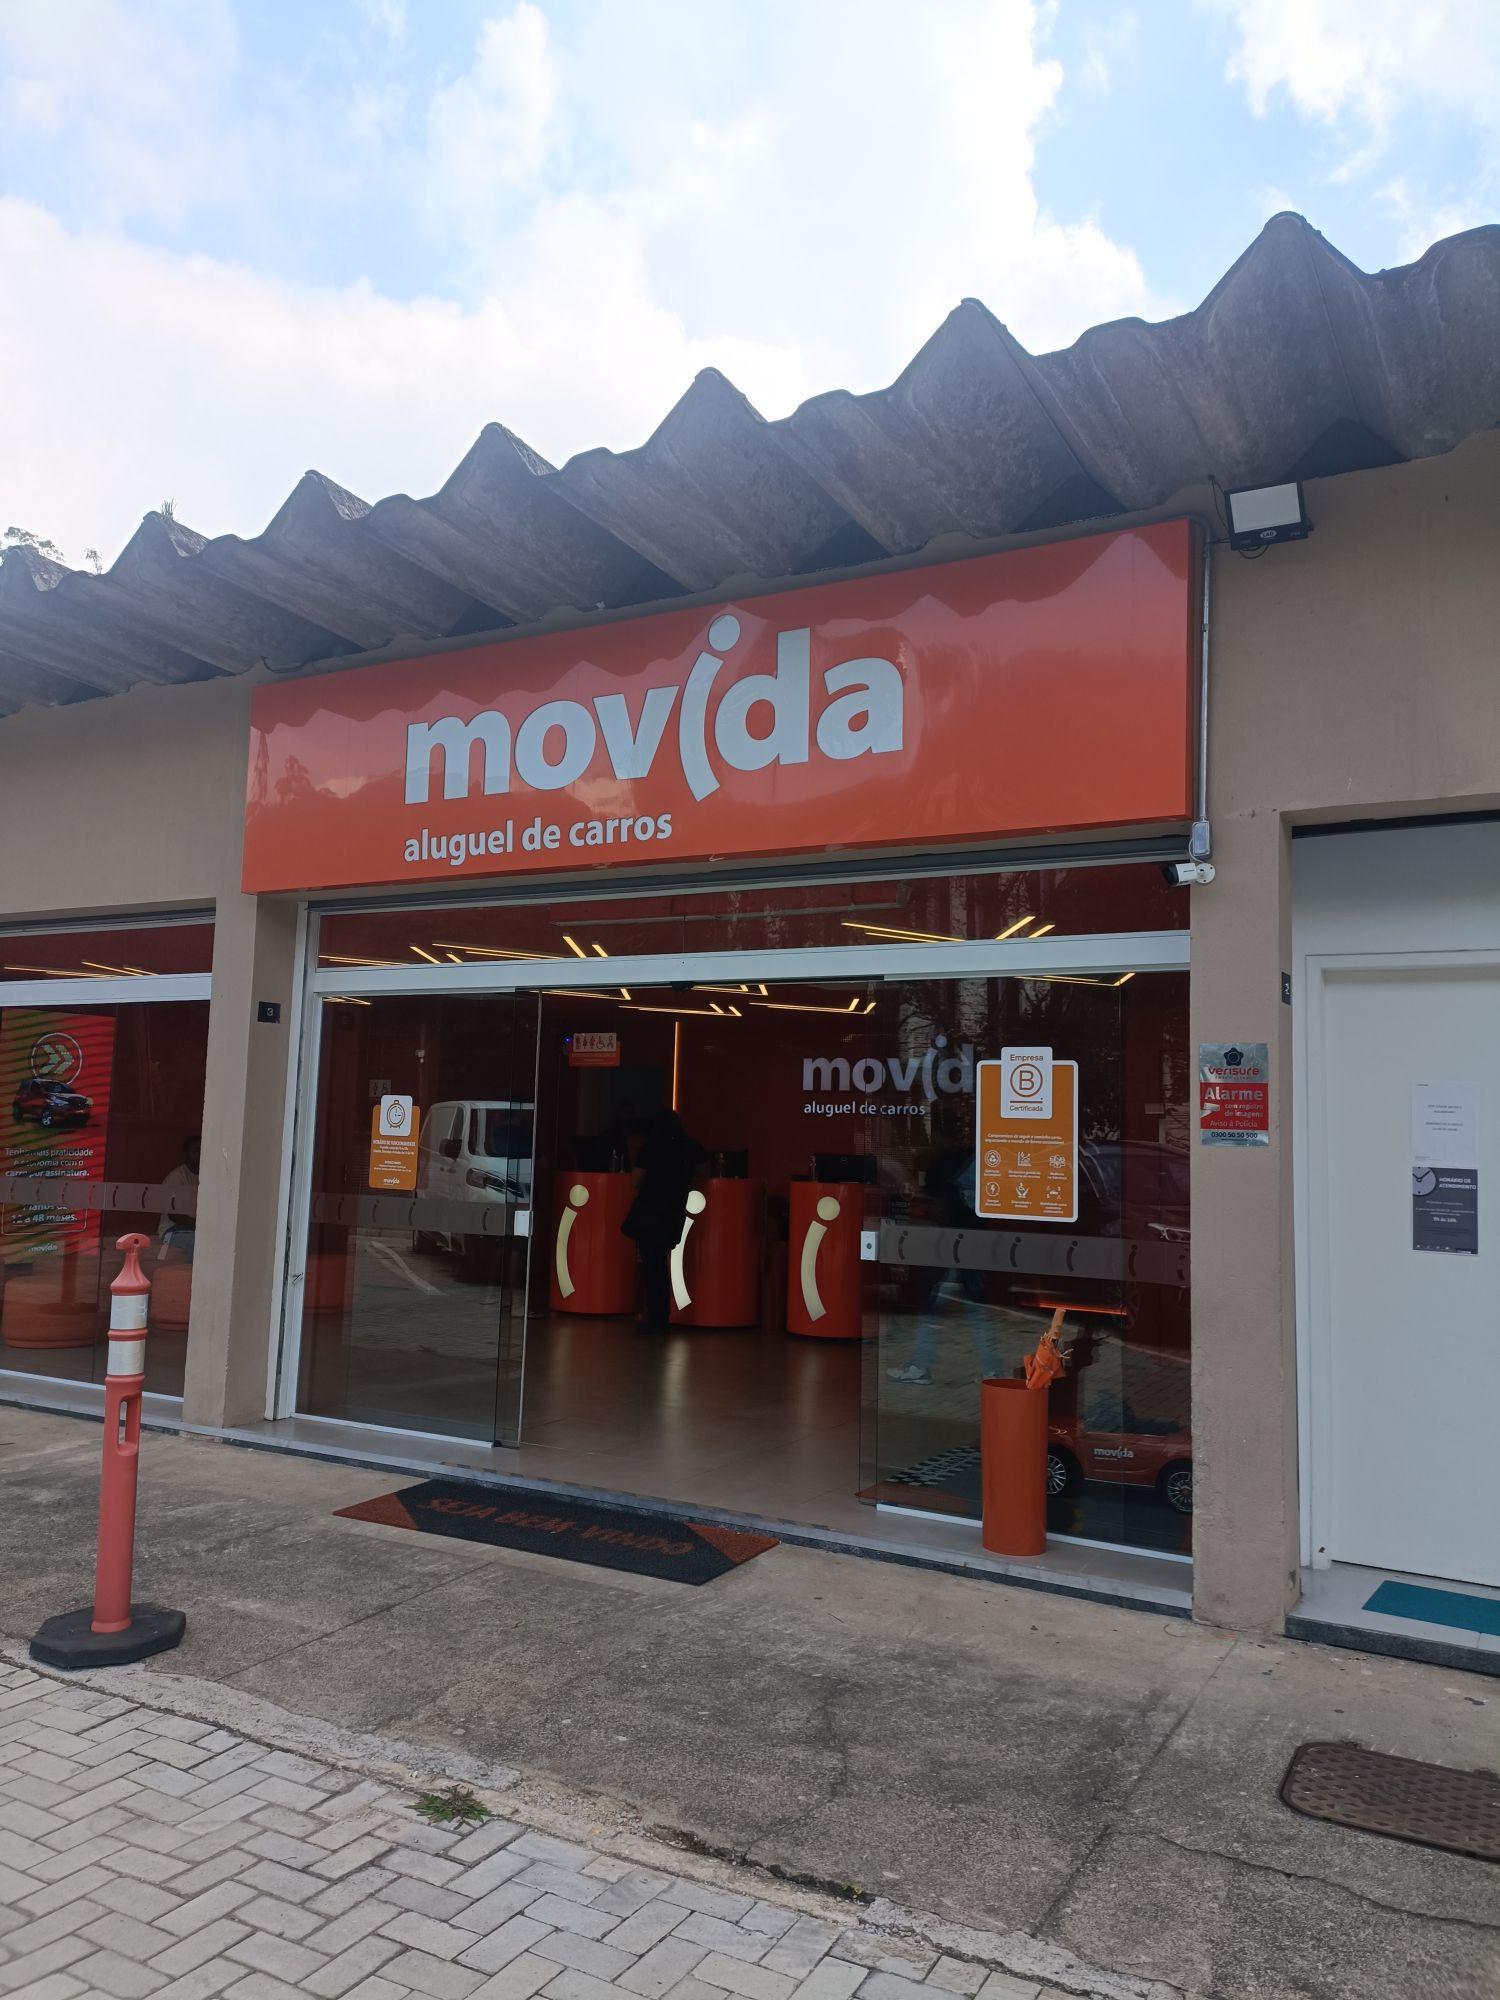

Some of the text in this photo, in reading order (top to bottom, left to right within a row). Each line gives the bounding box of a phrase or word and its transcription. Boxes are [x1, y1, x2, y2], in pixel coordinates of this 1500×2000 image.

[404, 614, 904, 805] movida
[404, 812, 673, 866] aluguel de carros
[267, 1007, 274, 1017] 3
[1009, 1054, 1044, 1062] Empresa
[802, 1034, 975, 1100] movid
[1208, 1066, 1260, 1076] verisure
[1019, 1070, 1035, 1090] B
[1204, 1086, 1264, 1101] Alarme
[803, 1101, 926, 1118] aluguel de carros
[50, 1147, 94, 1158] praticidade
[45, 1168, 90, 1178] assinatura.
[32, 1214, 45, 1223] 48
[1093, 1446, 1135, 1459] movida
